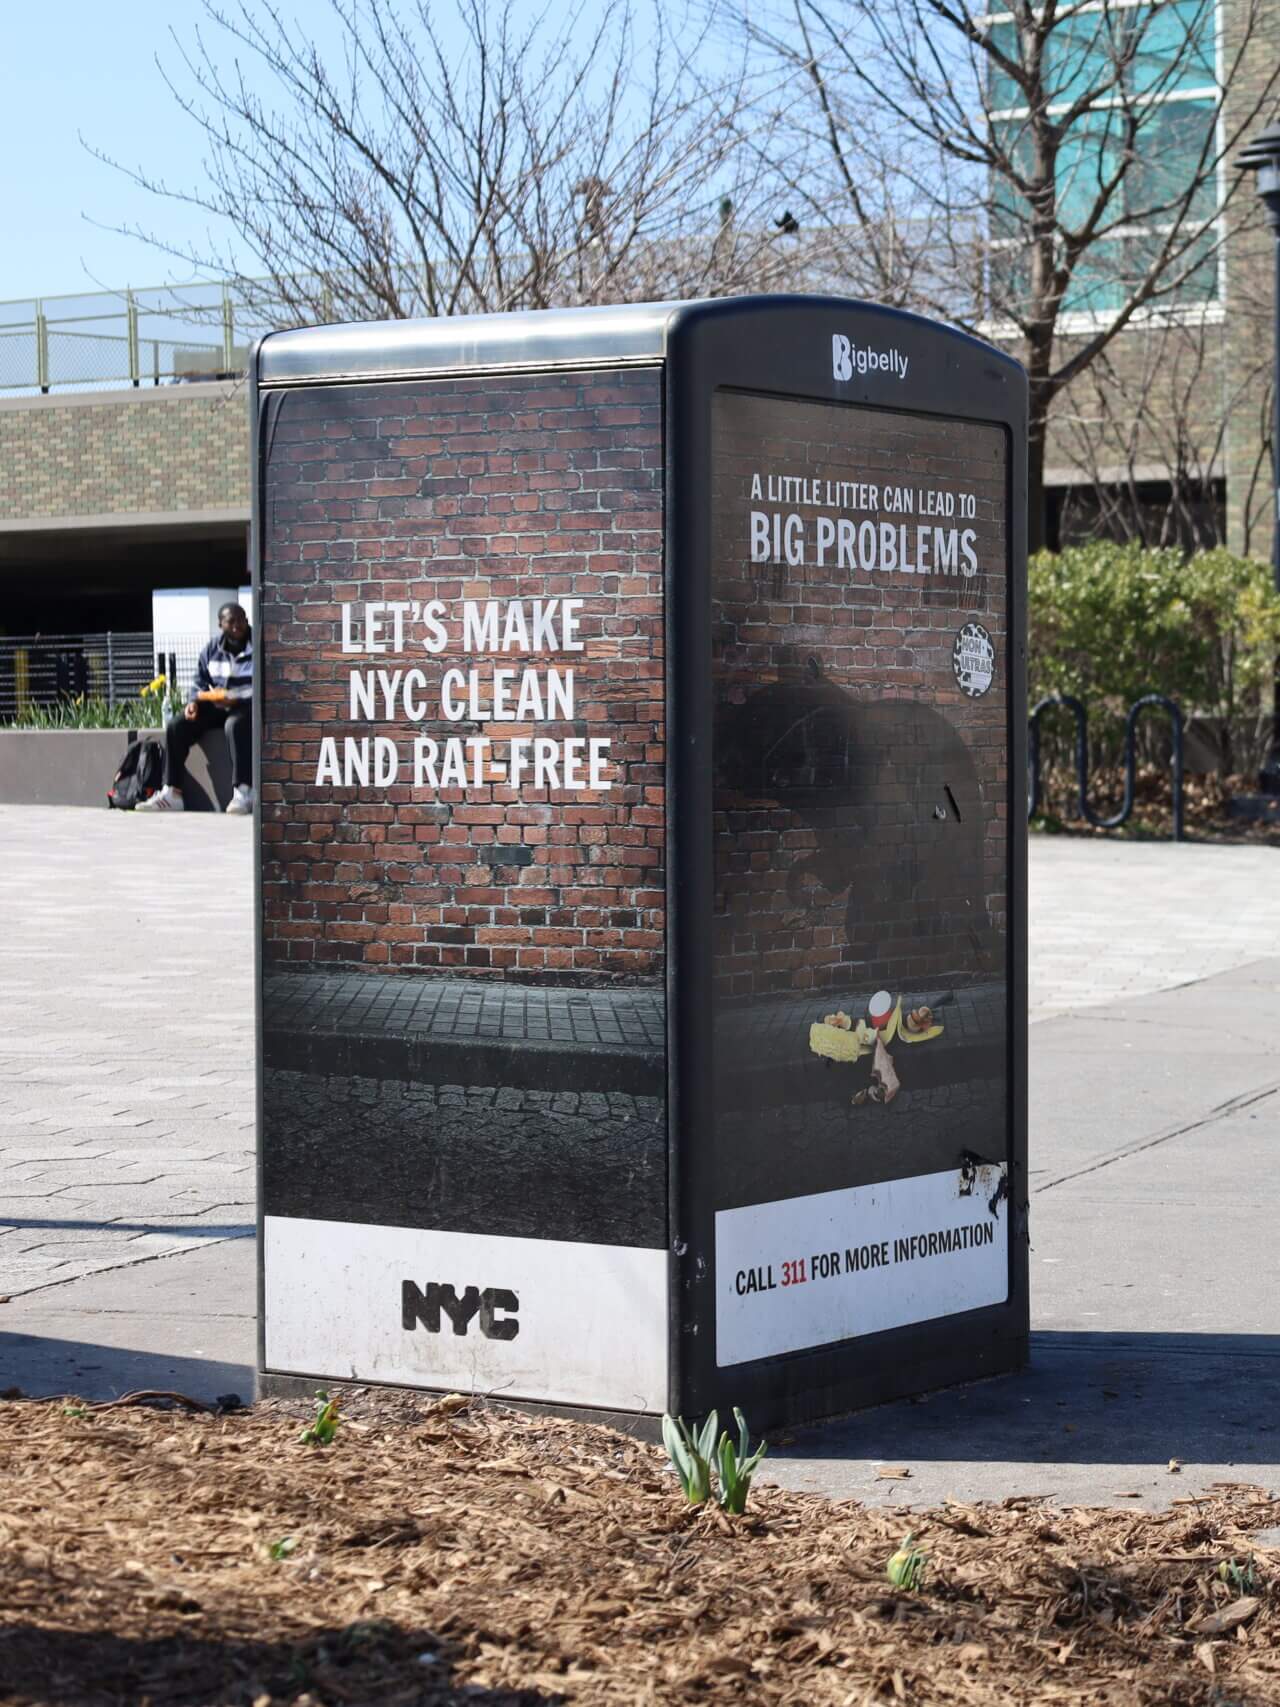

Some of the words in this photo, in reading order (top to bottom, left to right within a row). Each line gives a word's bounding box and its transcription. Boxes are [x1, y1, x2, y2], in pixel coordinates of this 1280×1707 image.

[832, 333, 909, 381] Bigbelly
[750, 473, 763, 500] A
[767, 474, 822, 506] LITTLE
[826, 480, 879, 512] LITTER
[883, 485, 914, 514] CAN
[918, 489, 956, 518] LEAD
[958, 493, 977, 519] TO
[750, 511, 804, 567] BIG
[816, 516, 978, 578] PROBLEMS
[341, 600, 448, 654] LET'S
[463, 598, 585, 653] MAKE
[350, 668, 428, 722] NYC
[441, 668, 575, 722] CLEAN
[315, 736, 399, 788] AND
[413, 737, 613, 790] RAT-FREE
[735, 1264, 777, 1296] CALL
[780, 1257, 808, 1287] 311
[811, 1251, 841, 1281] FOR
[845, 1241, 890, 1274] MORE
[894, 1221, 994, 1265] INFORMATION
[401, 1279, 520, 1341] NYC
